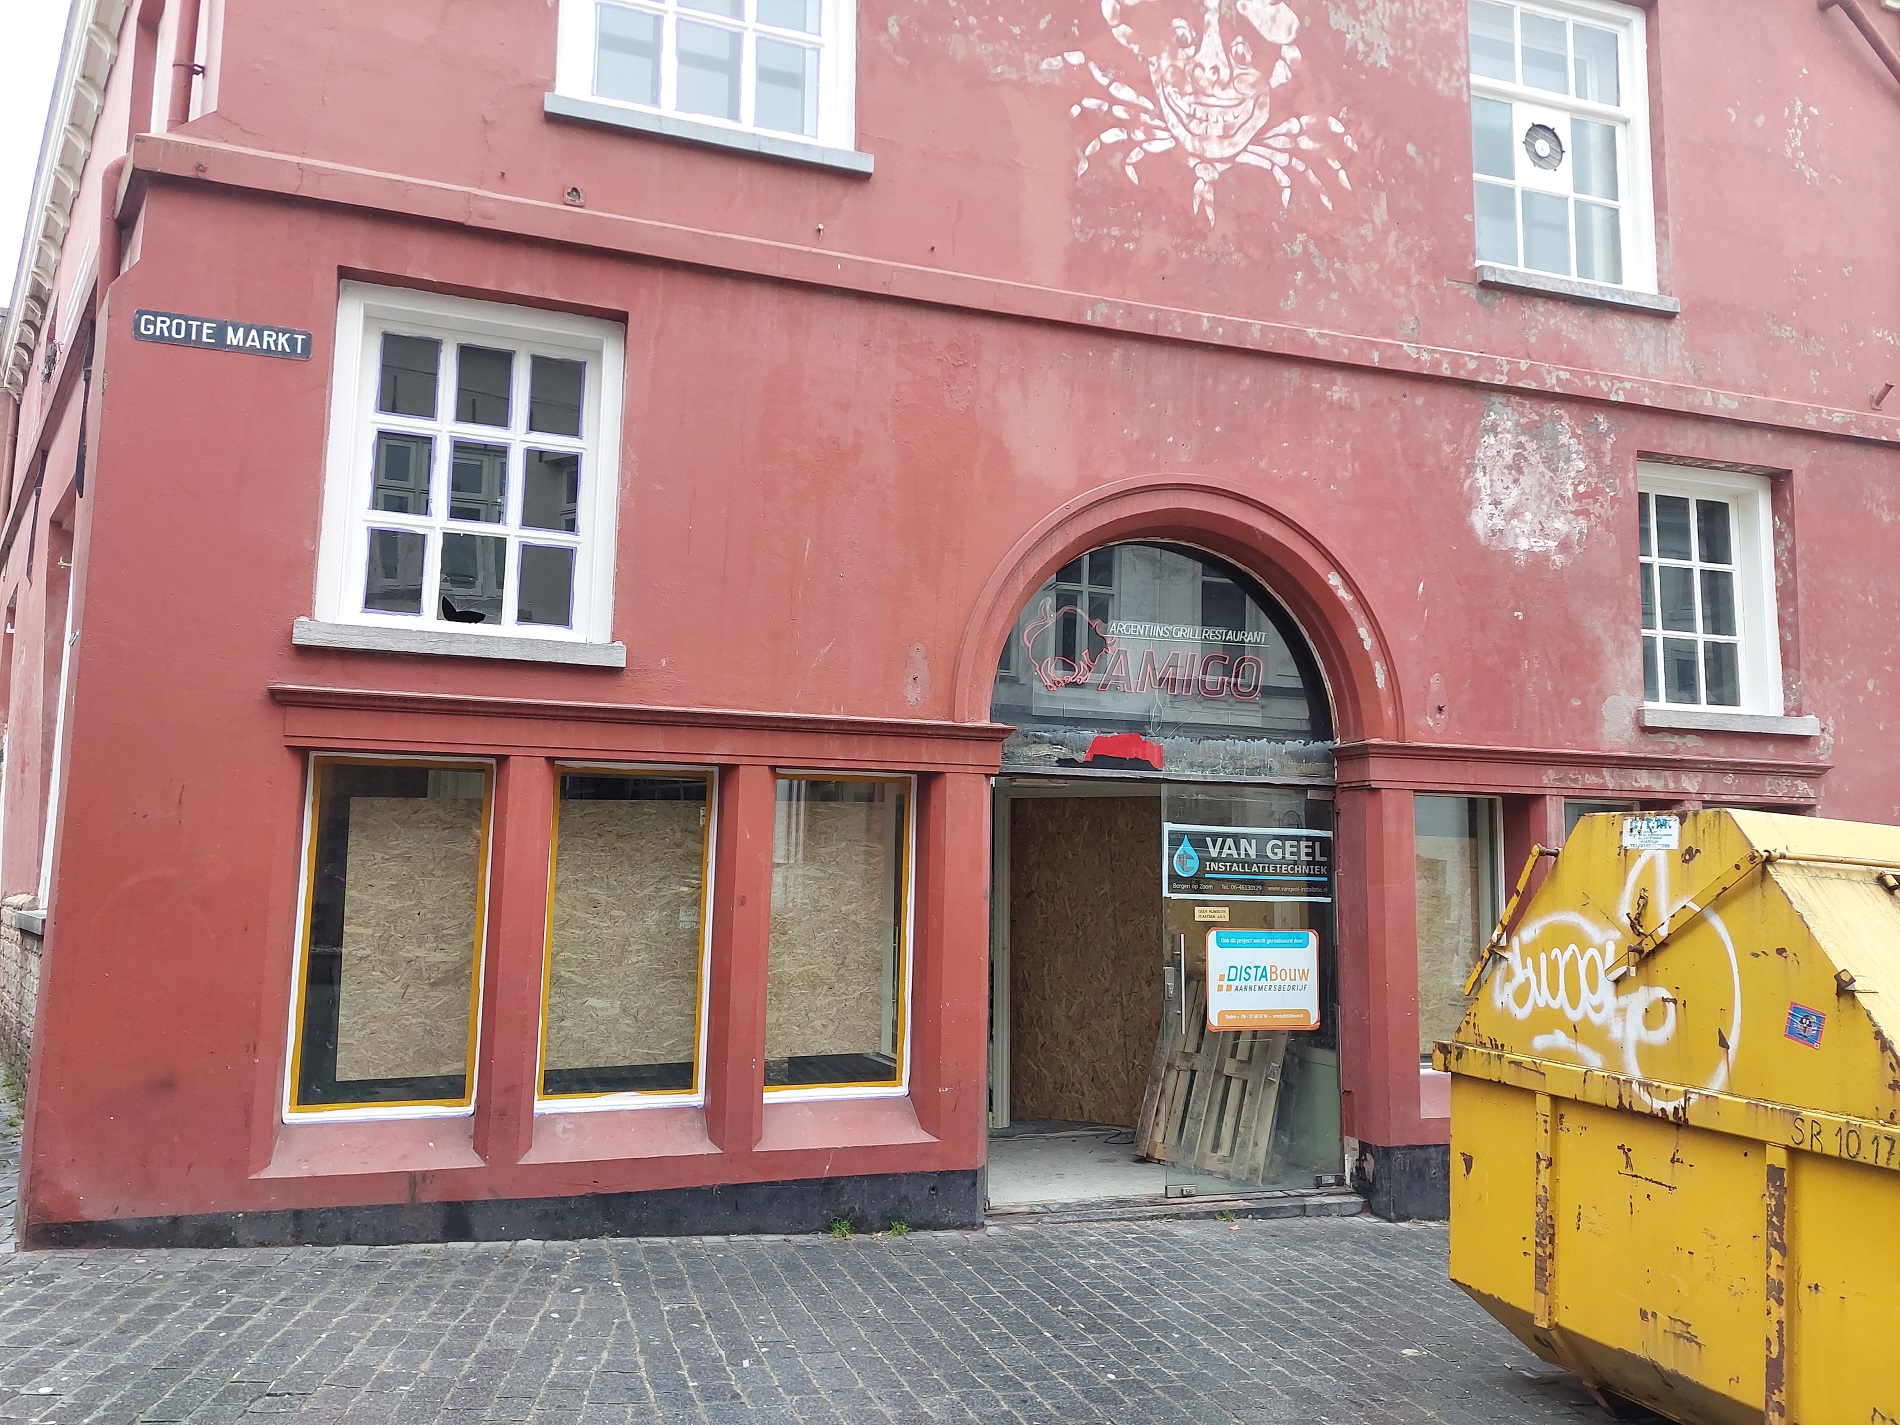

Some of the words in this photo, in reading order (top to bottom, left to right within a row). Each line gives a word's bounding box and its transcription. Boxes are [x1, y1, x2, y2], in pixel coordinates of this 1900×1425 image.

[139, 314, 217, 343] GROTE
[226, 325, 307, 354] MARKT
[1172, 627, 1200, 639] GRILL
[1201, 628, 1268, 644] RESTAURANT
[1098, 648, 1263, 699] AMIGO
[1205, 837, 1257, 859] VAN
[1266, 839, 1328, 862] GEEL
[1205, 862, 1328, 874] INSTALLATIETECHNIEK
[1172, 882, 1191, 890] Bergen
[1234, 984, 1308, 992] AANNEMERSBEDRIJF
[1791, 1117, 1823, 1153] SR
